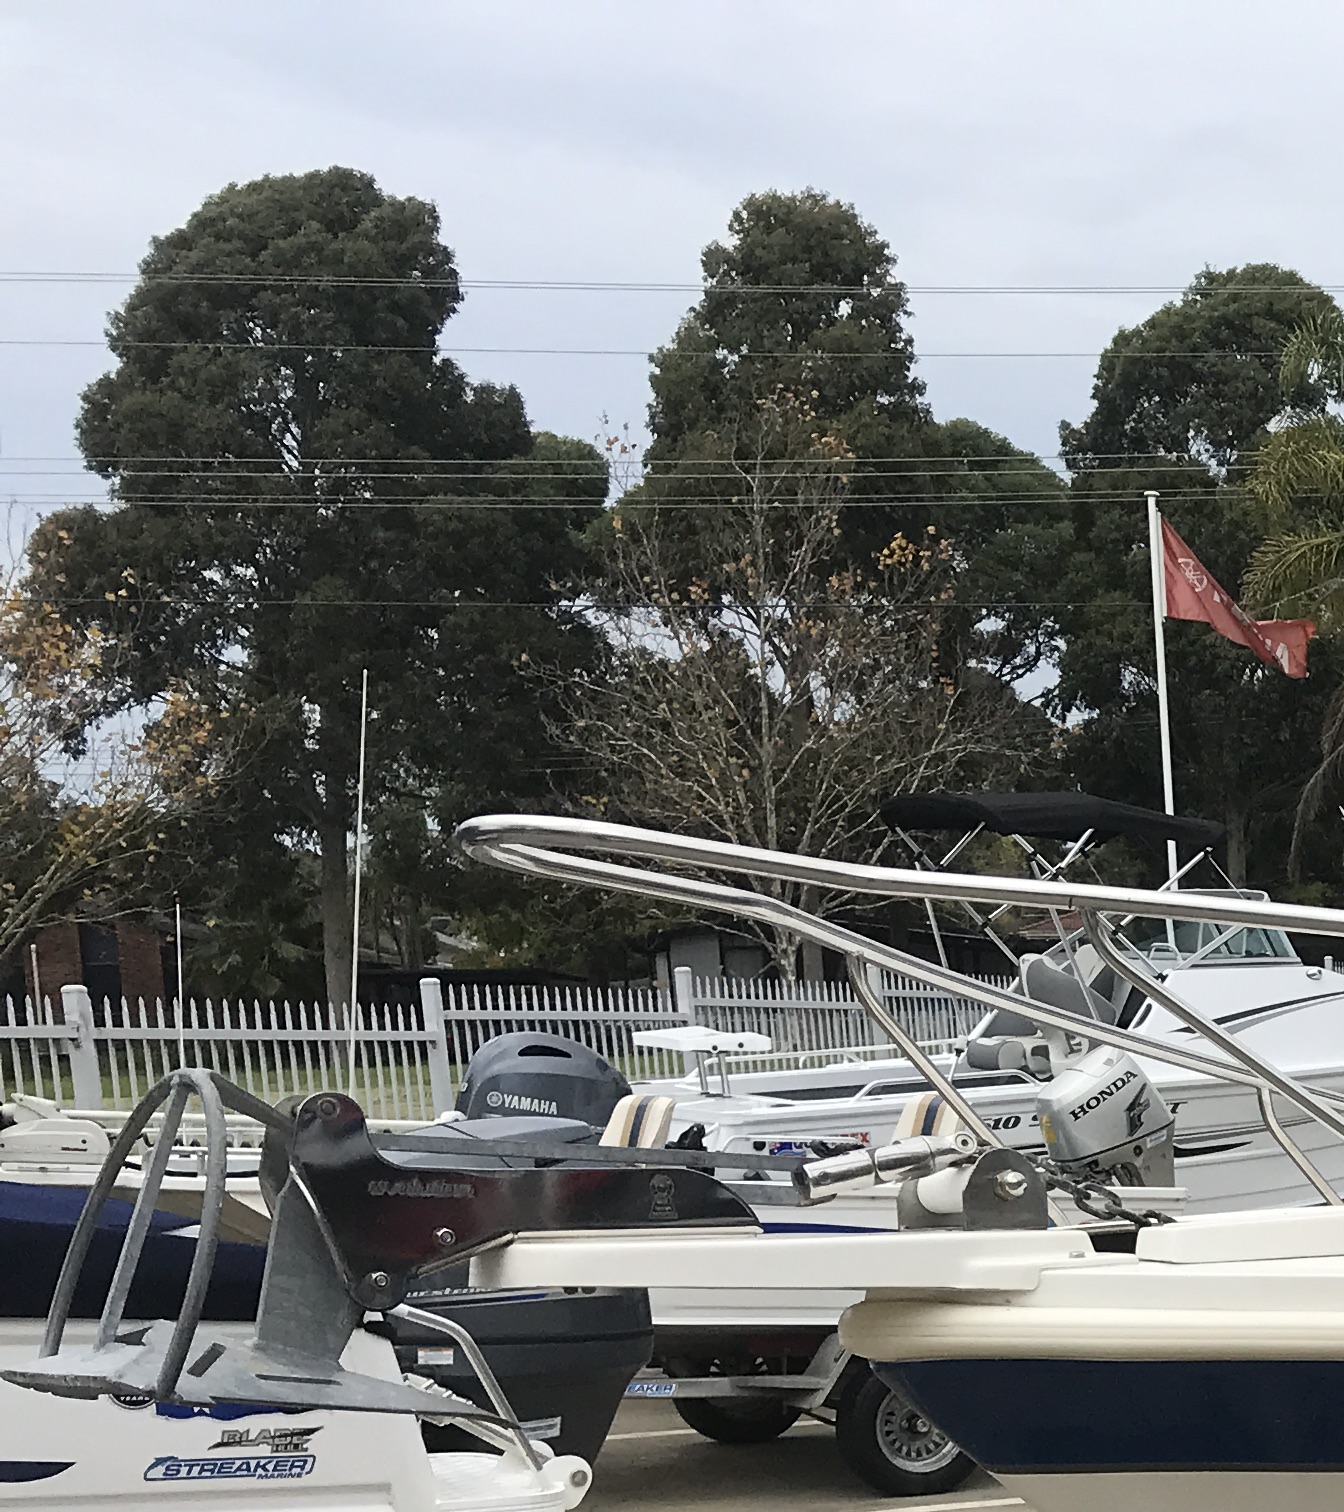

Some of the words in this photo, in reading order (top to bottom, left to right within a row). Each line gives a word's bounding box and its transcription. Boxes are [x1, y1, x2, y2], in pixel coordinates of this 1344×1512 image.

[503, 1093, 558, 1115] YAMAHA
[1069, 1070, 1138, 1121] HONDA
[627, 1384, 674, 1394] EAKER
[220, 1428, 313, 1450] BLADE
[162, 1458, 308, 1478] STREAKER
[256, 1472, 303, 1480] MARINE
